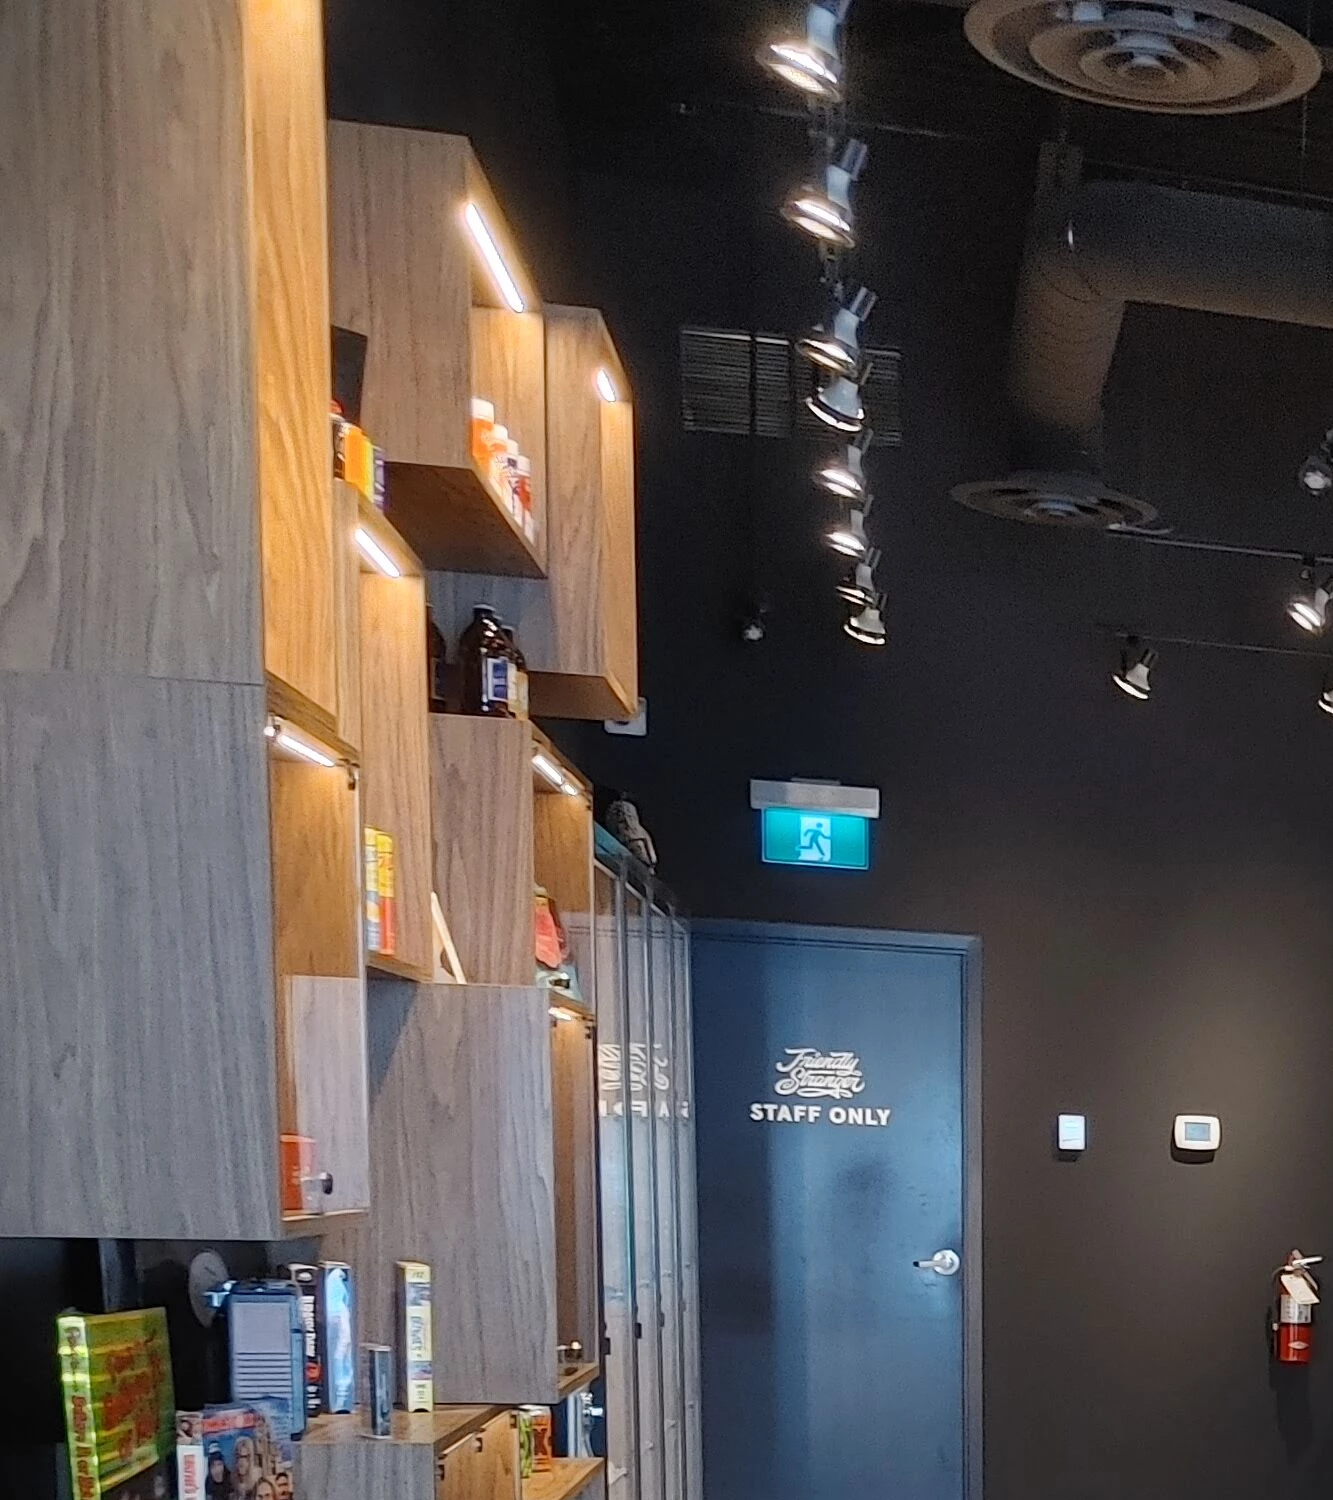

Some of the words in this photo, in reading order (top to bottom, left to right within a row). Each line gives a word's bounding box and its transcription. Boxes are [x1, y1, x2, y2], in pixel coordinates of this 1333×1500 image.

[775, 1048, 863, 1077] Friendly
[774, 1068, 865, 1099] Stranger
[750, 1103, 822, 1123] STAFF
[829, 1106, 891, 1126] ONLY
